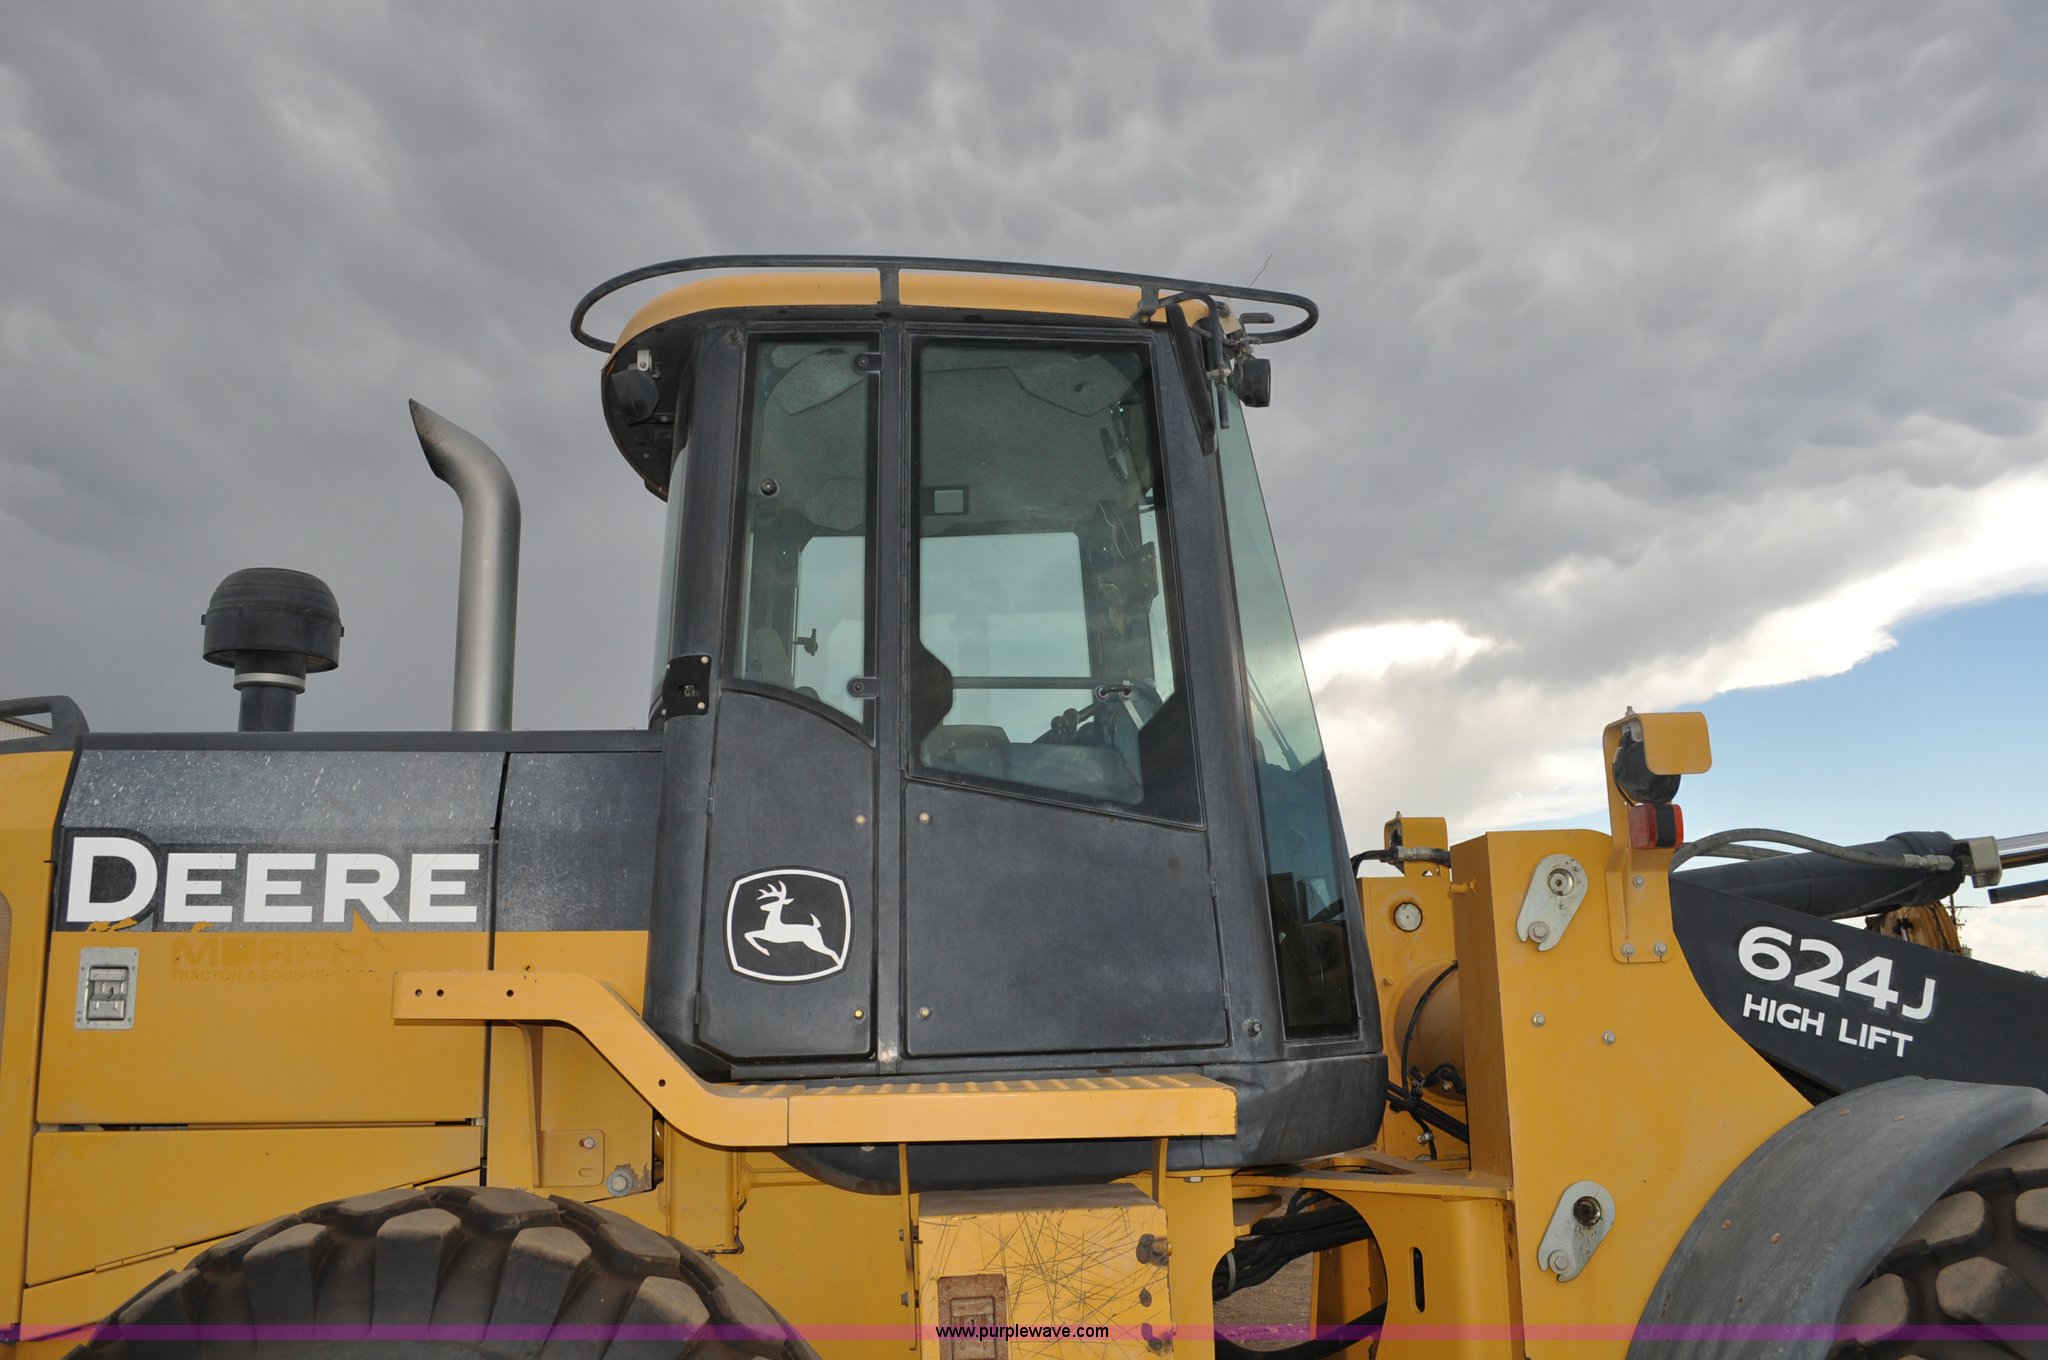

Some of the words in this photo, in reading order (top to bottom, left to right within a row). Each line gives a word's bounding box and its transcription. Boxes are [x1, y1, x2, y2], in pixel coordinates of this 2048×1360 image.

[66, 836, 480, 923] DEERE
[170, 970, 241, 982] TRACTOR
[172, 937, 400, 967] MRPHY
[1738, 926, 1936, 1020] 624J
[1743, 993, 1825, 1036] HIGH
[1838, 1018, 1913, 1057] LIFT
